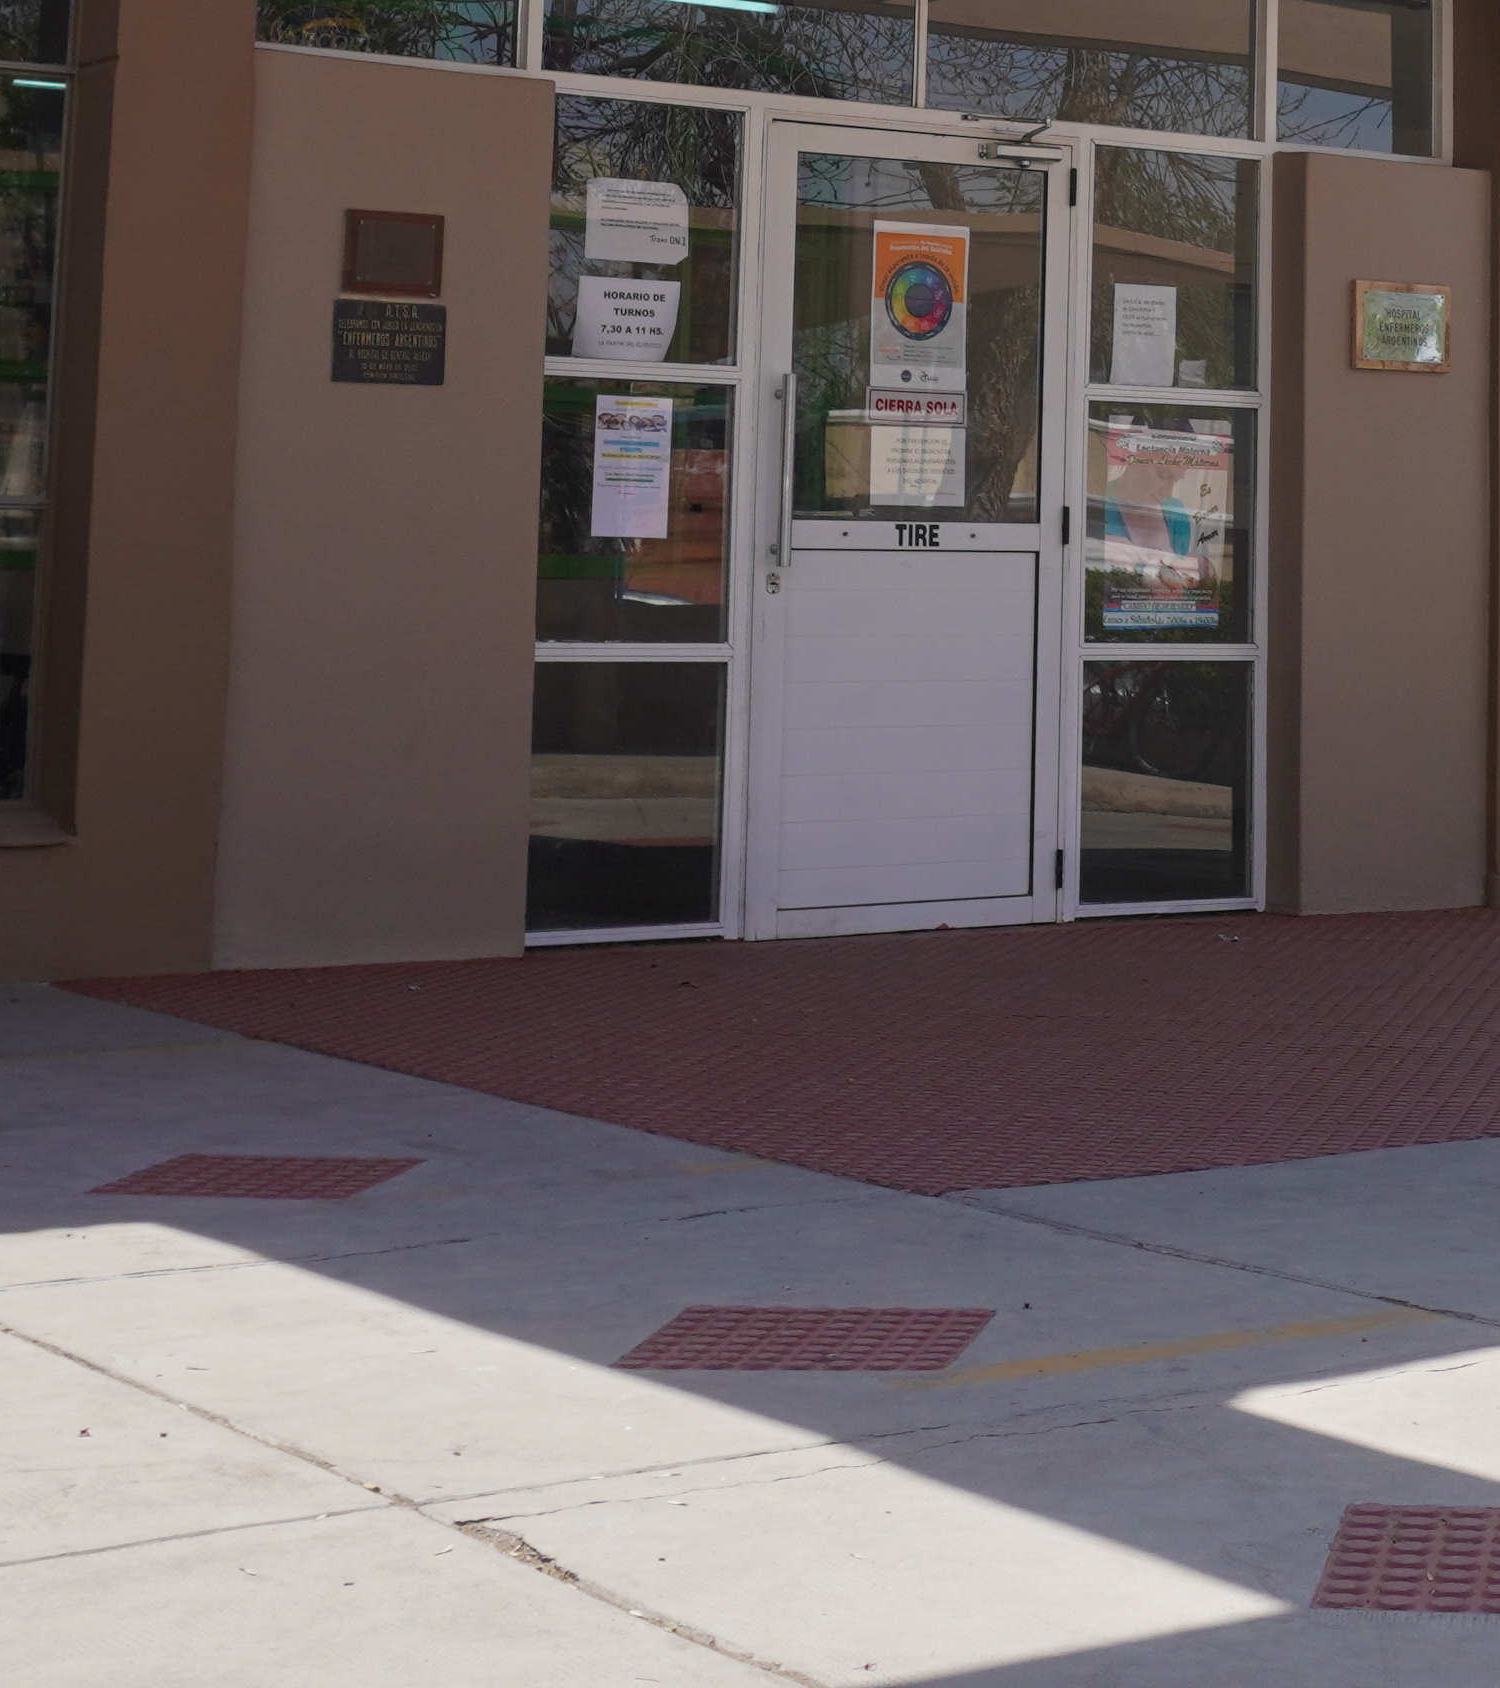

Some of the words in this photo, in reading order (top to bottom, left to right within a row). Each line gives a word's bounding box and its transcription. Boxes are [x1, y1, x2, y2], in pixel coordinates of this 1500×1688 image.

[603, 291, 650, 301] HORARIO
[653, 294, 666, 302] DE
[614, 308, 655, 317] TURNOS
[1386, 309, 1421, 321] HOSPITAL
[601, 324, 622, 334] 7,30
[625, 326, 632, 334] A
[636, 326, 646, 335] 11
[650, 327, 664, 336] HS.
[1379, 322, 1430, 334] ENFERMEROS
[1380, 335, 1428, 347] ARGENTINOS
[875, 398, 922, 414] CIERRA
[926, 401, 959, 416] SOLA
[1136, 444, 1177, 455] Lactancia
[1178, 445, 1211, 455] Materna
[895, 523, 940, 547] TIRE
